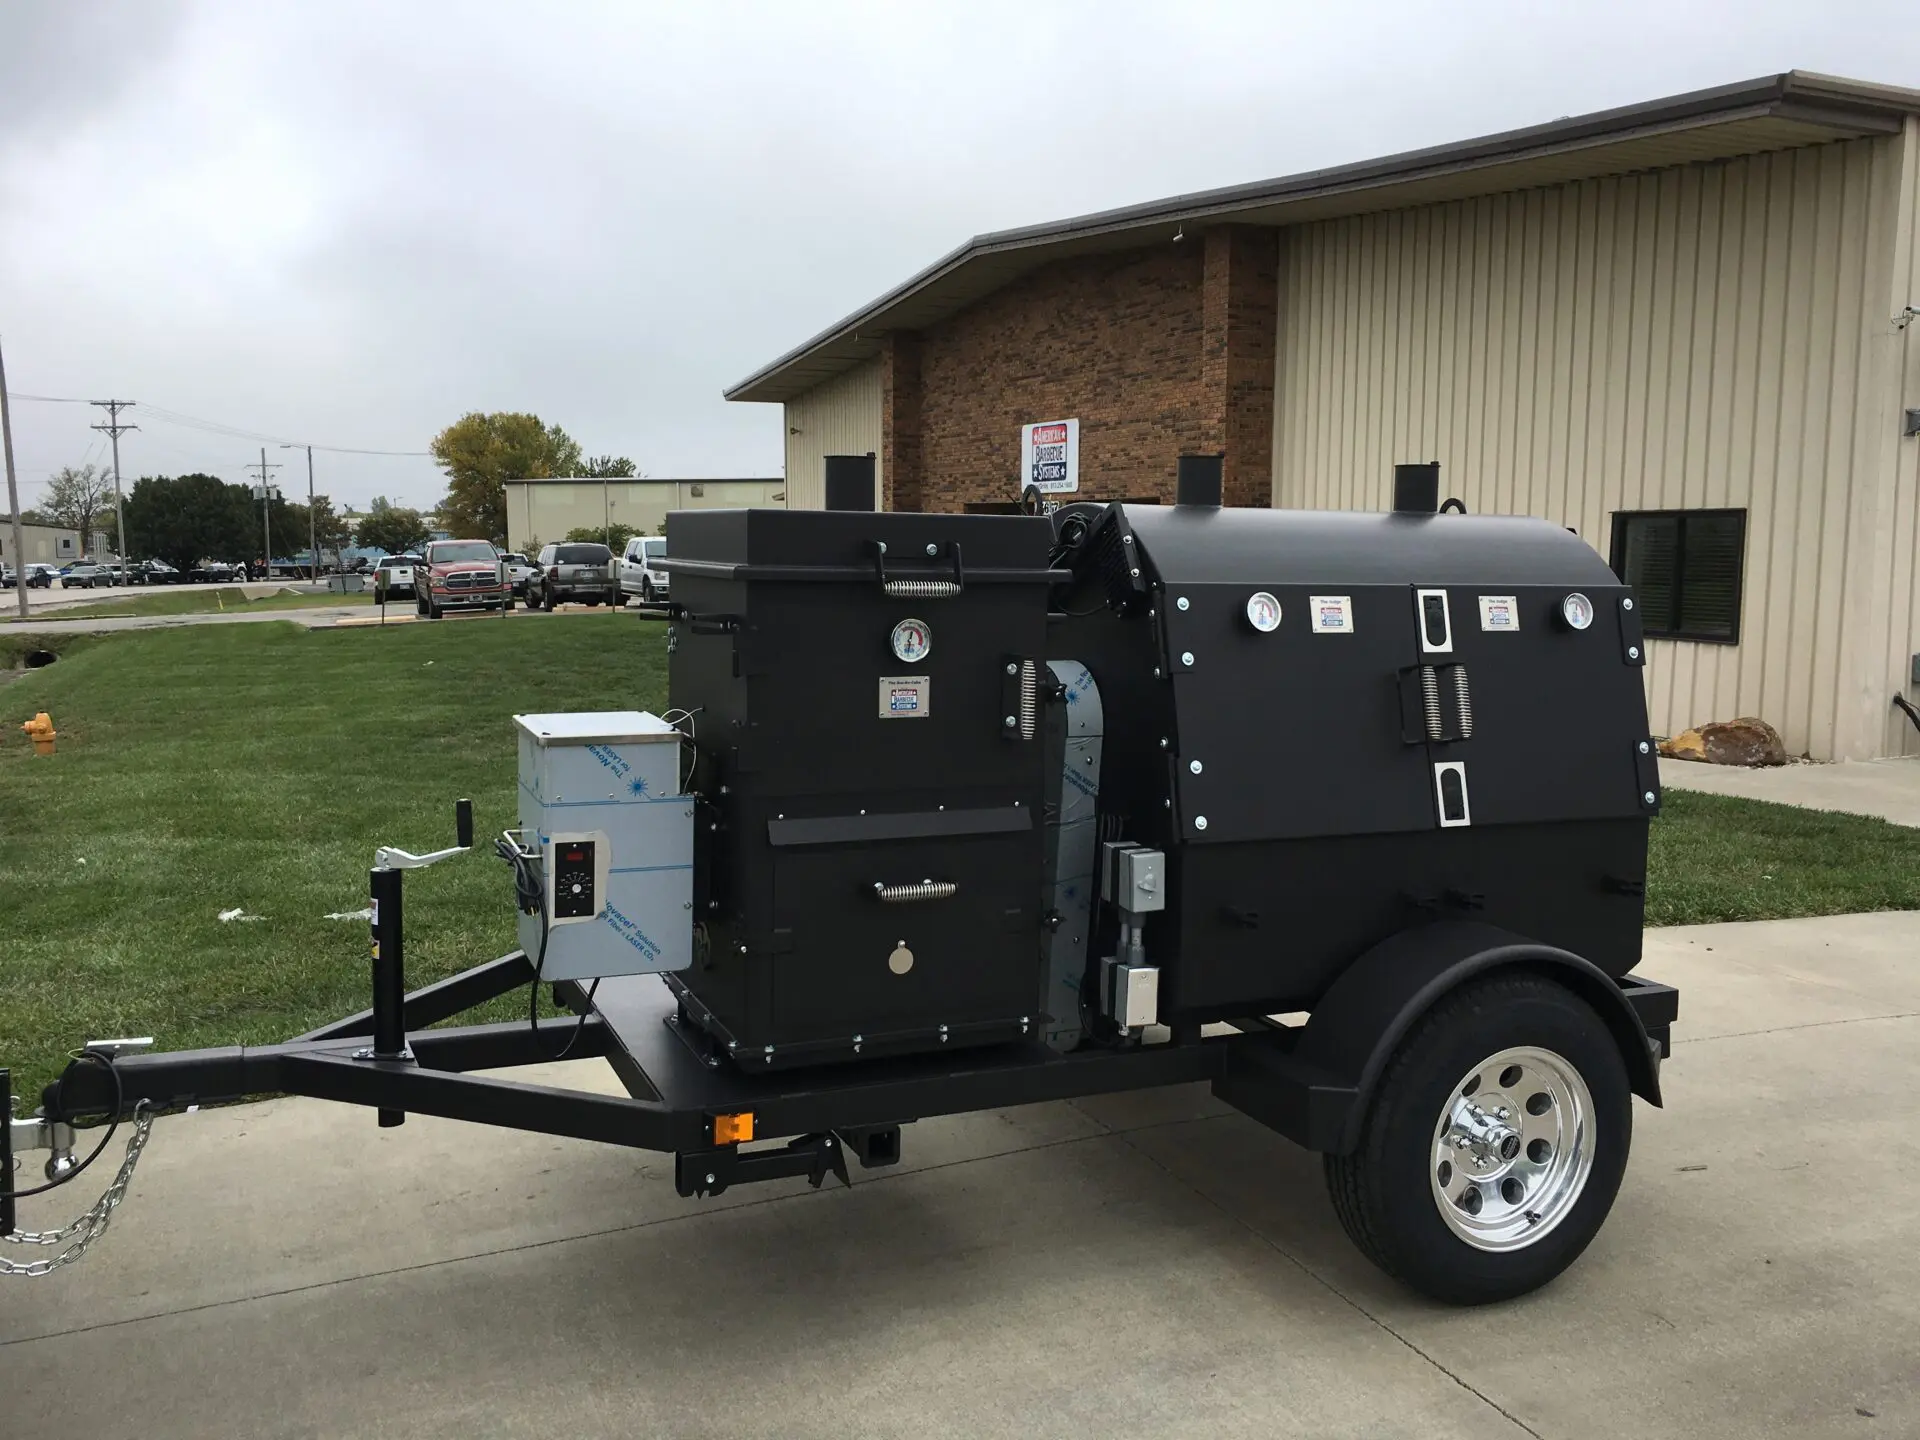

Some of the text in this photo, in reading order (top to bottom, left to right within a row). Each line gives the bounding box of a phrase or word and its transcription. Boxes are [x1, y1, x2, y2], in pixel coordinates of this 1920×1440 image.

[1036, 446, 1063, 463] BARBECUE
[1038, 465, 1060, 480] SYSTEMS
[611, 765, 624, 779] The
[625, 934, 645, 953] LASER
[635, 929, 661, 955] Solution
